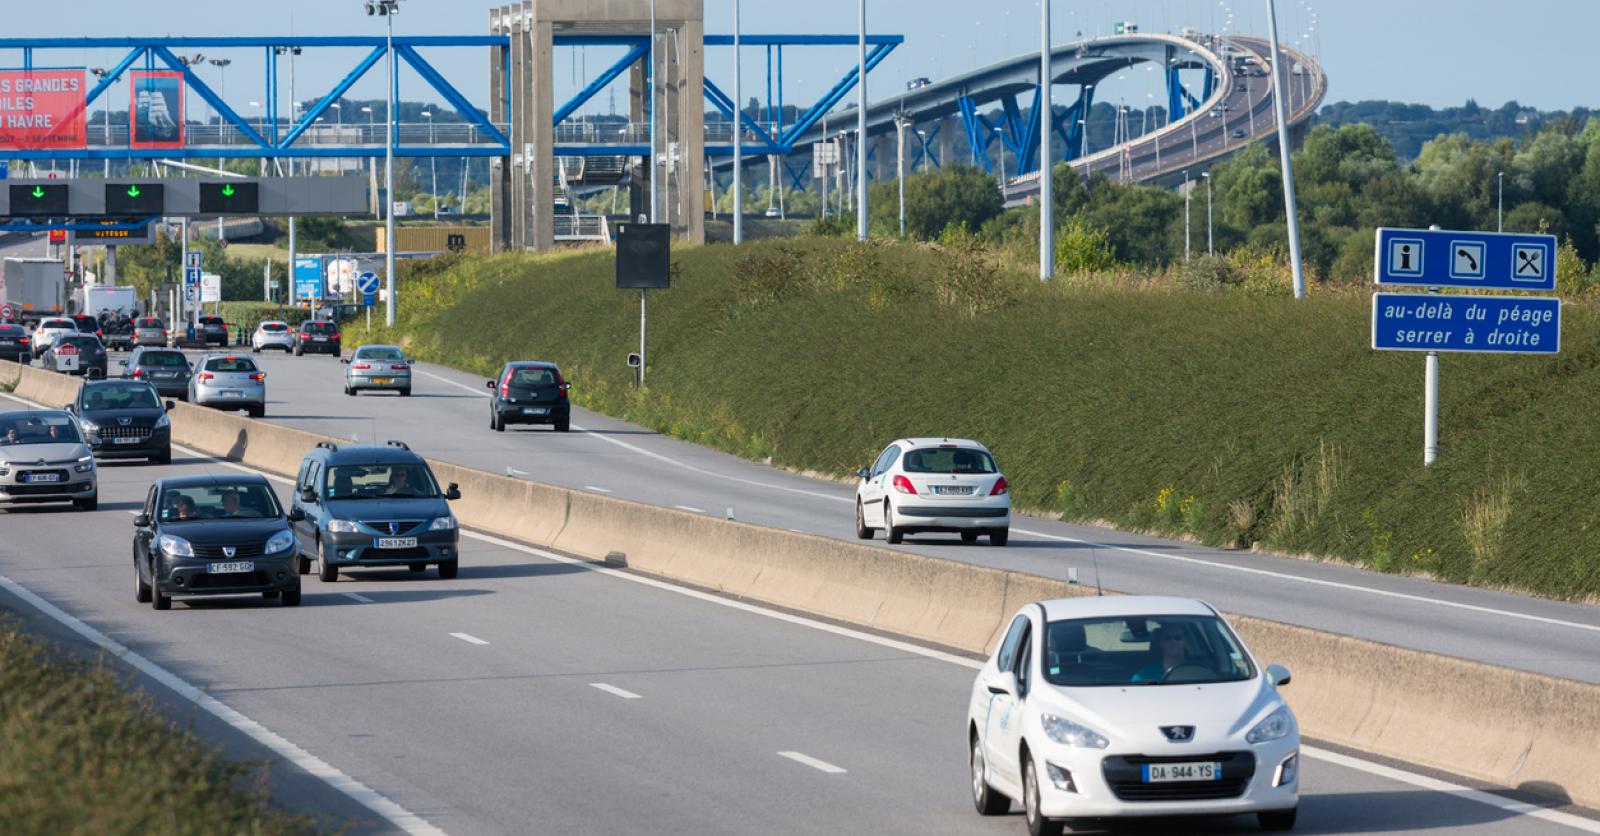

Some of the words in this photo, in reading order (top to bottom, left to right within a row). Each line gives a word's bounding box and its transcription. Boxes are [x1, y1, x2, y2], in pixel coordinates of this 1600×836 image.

[15, 78, 79, 93] GRANDES
[0, 97, 34, 111] ILES
[7, 114, 53, 128] HAVRE
[1384, 302, 1453, 320] au-delà
[1465, 303, 1487, 320] du
[1497, 304, 1553, 327] péage
[1395, 328, 1452, 343] serrer
[1464, 327, 1475, 345] à
[1487, 328, 1541, 346] droite
[64, 357, 72, 366] 4
